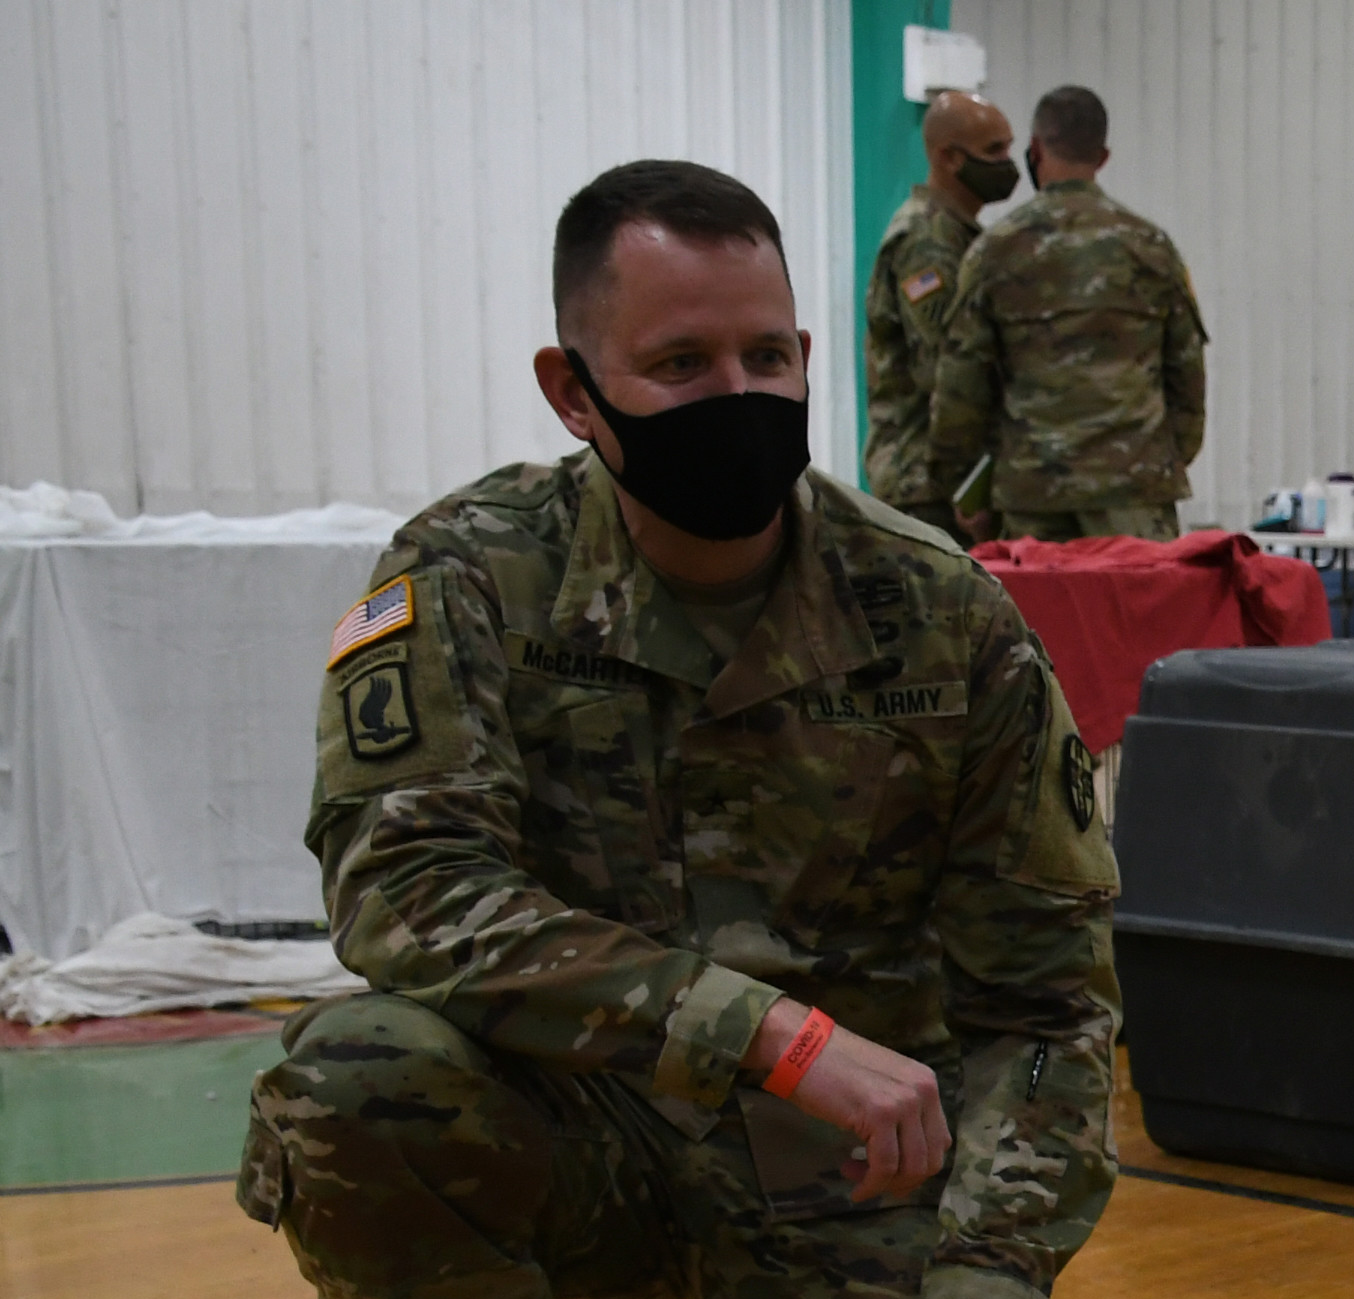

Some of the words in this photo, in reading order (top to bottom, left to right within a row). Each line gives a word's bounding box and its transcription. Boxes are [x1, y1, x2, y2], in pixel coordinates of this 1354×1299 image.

[522, 640, 650, 685] McCARTE
[819, 694, 864, 718] U.S.
[874, 688, 941, 718] ARMY
